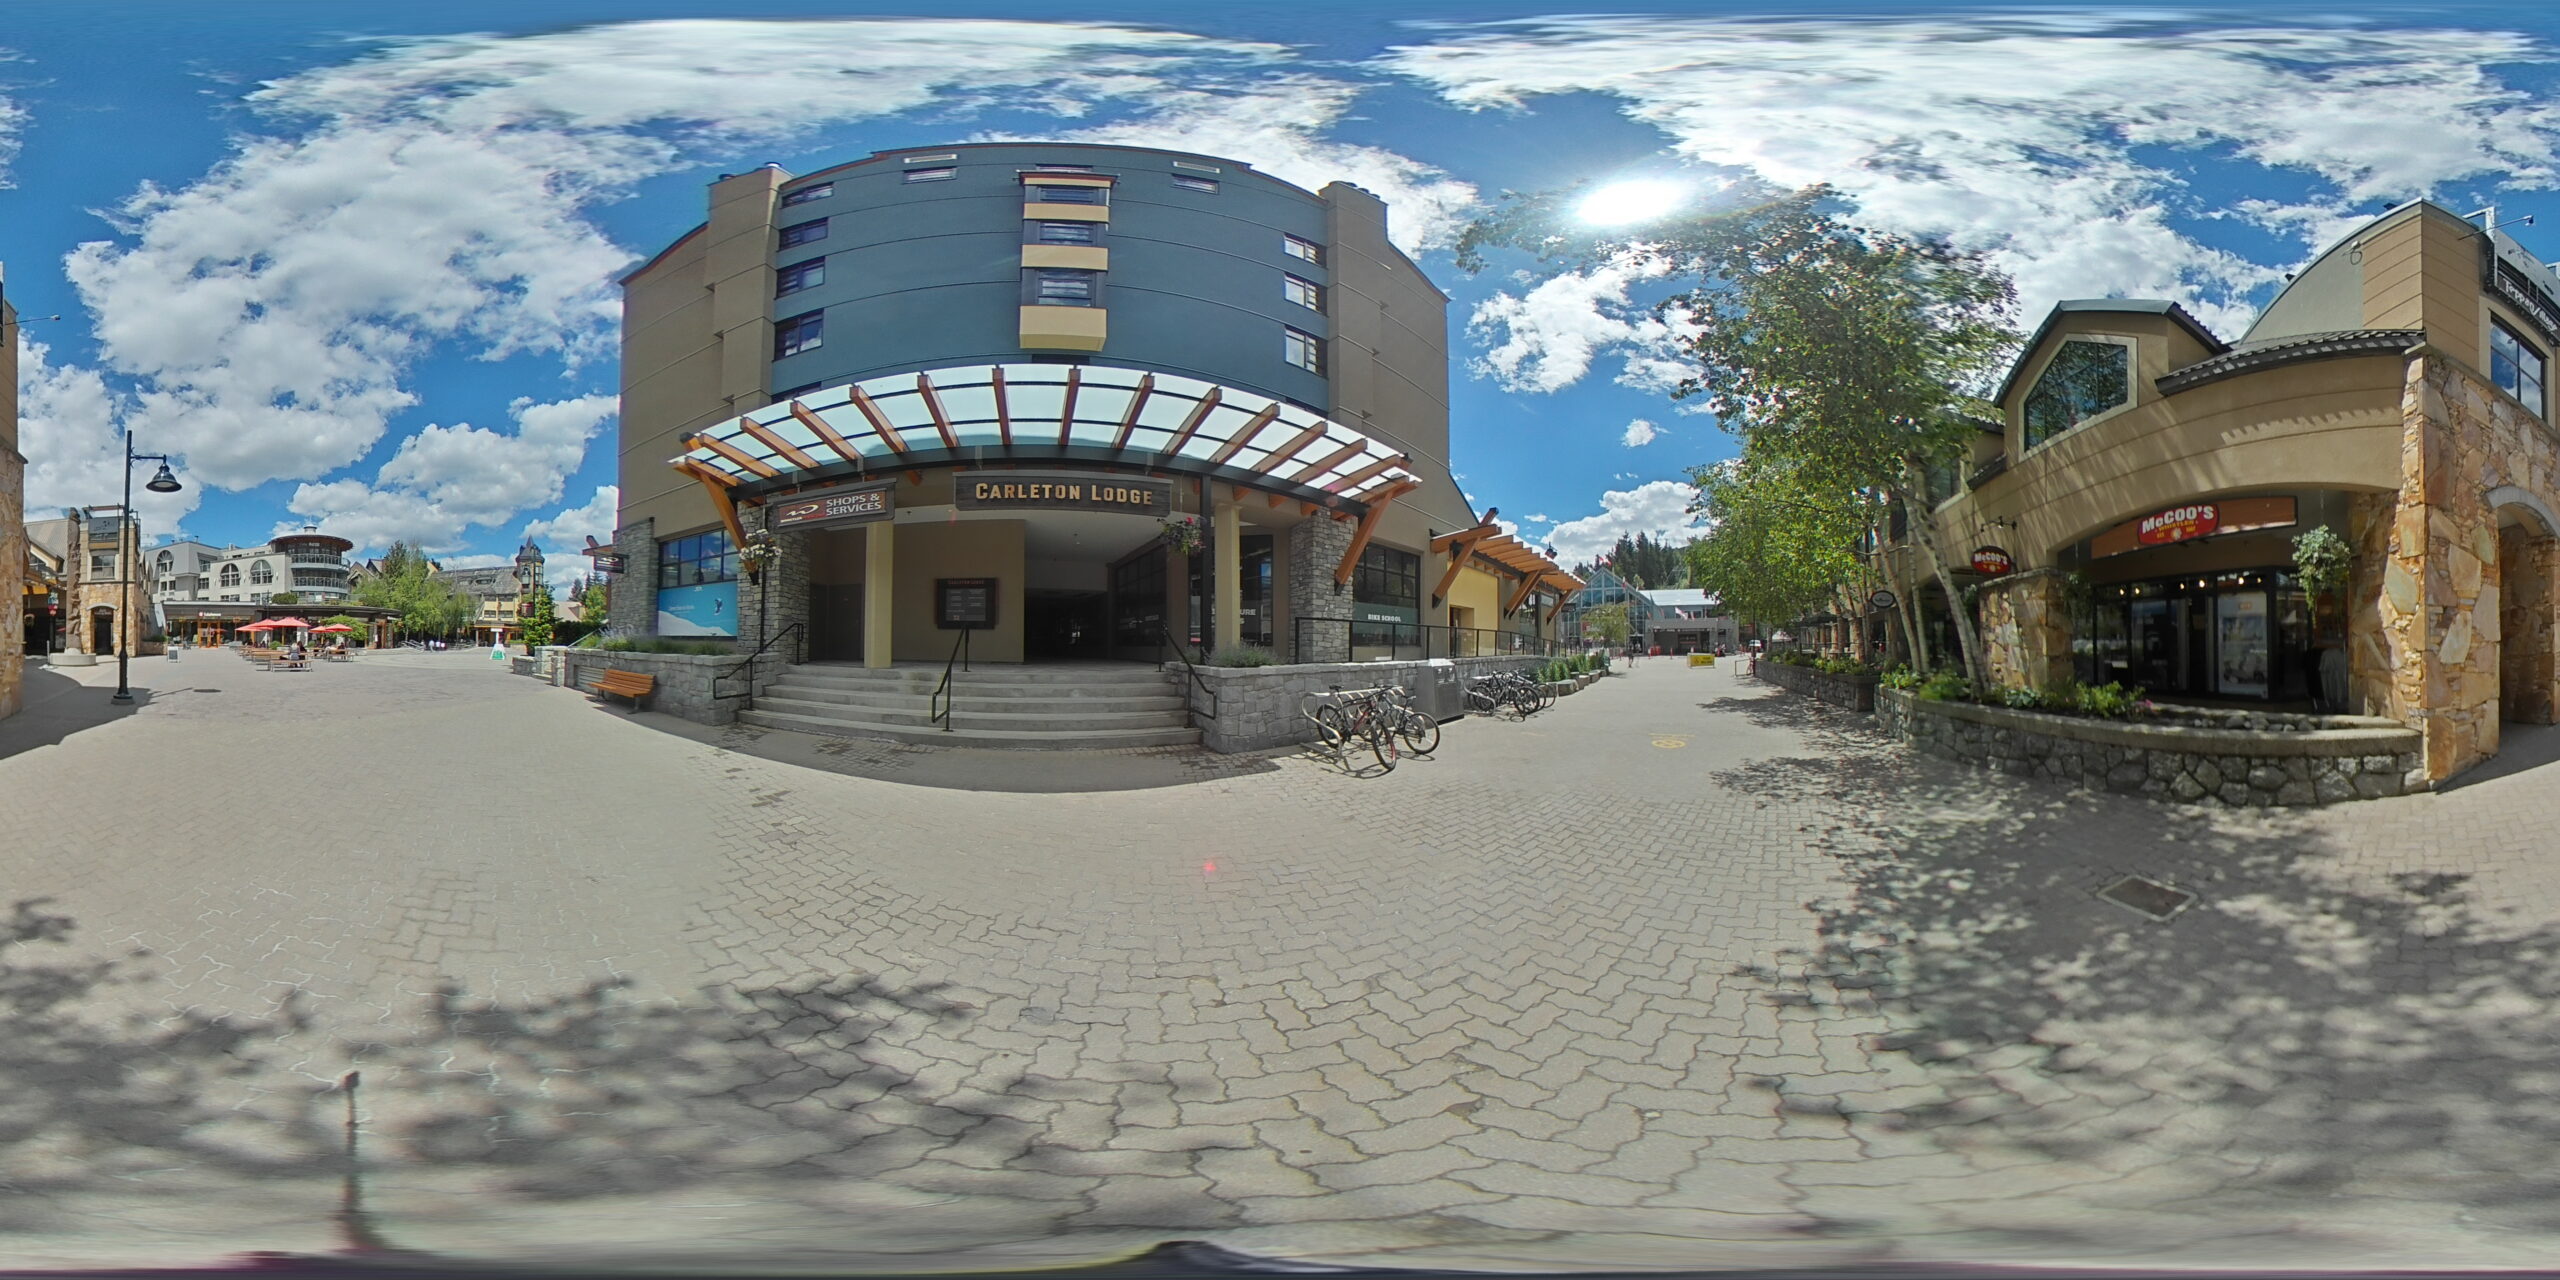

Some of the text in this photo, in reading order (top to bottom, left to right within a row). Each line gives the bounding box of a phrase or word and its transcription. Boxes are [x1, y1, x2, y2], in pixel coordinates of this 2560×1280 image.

[826, 493, 880, 508] SHOPS &
[975, 482, 1153, 505] CARLETON LODGE
[826, 501, 882, 516] SERVICES
[1367, 613, 1402, 622] BIKE SCHOOL
